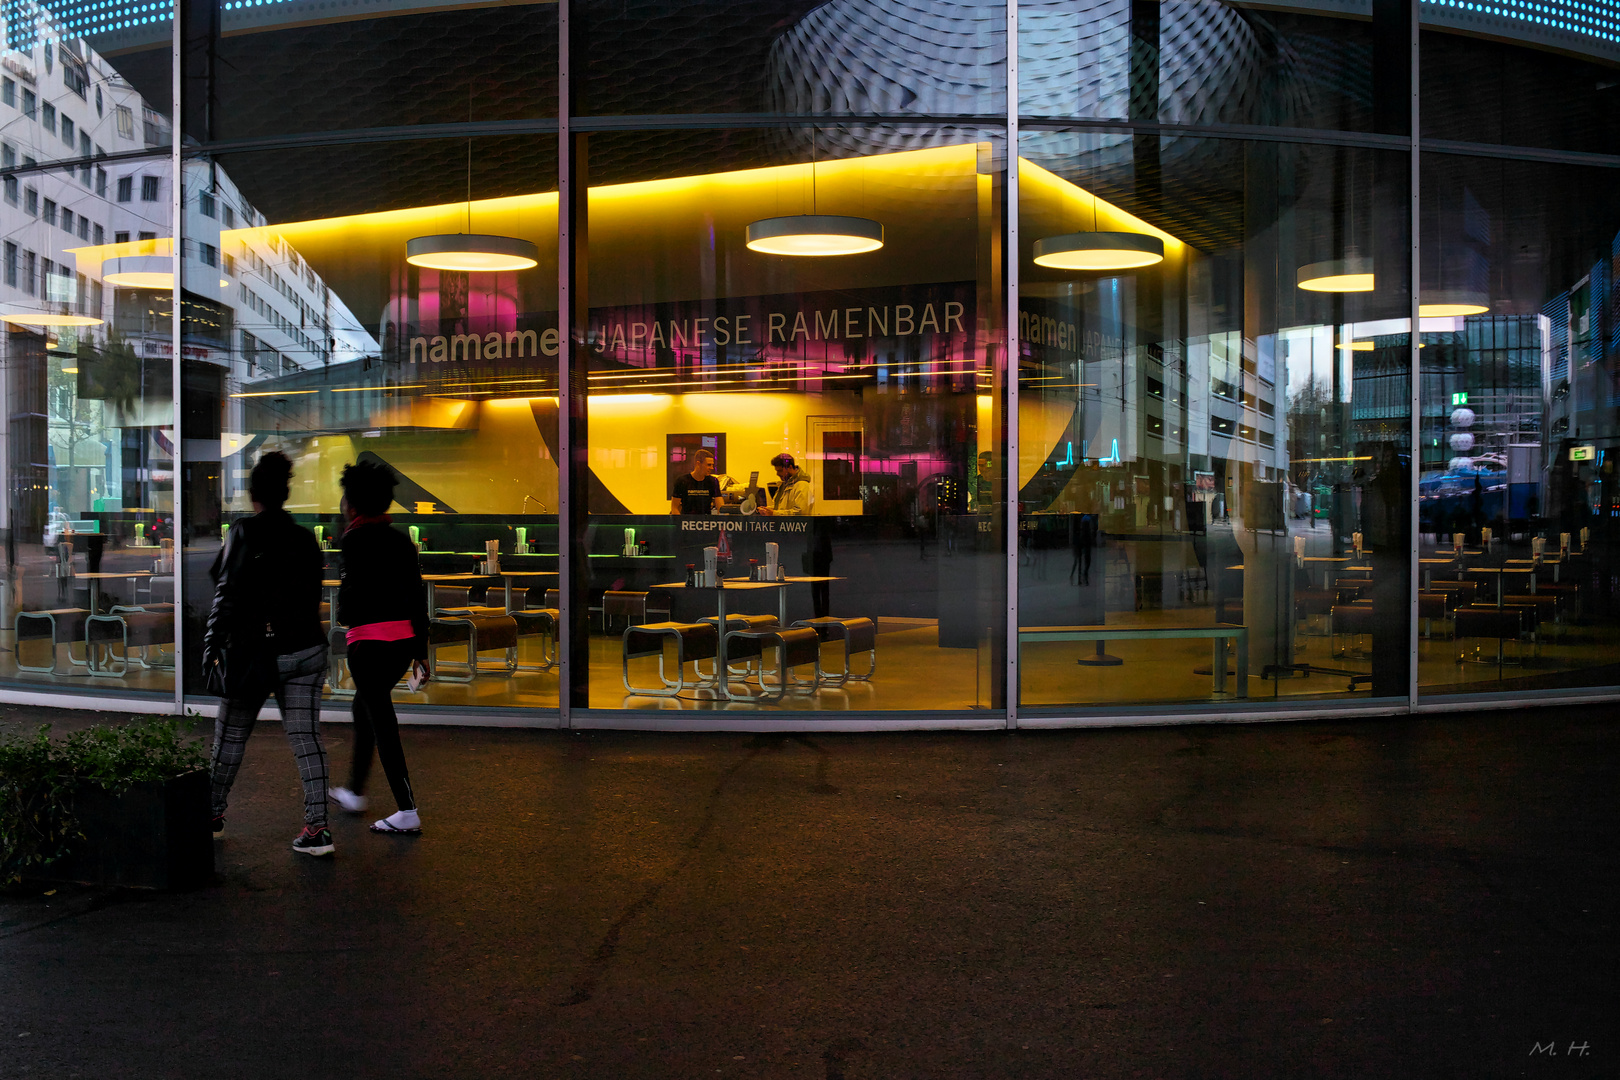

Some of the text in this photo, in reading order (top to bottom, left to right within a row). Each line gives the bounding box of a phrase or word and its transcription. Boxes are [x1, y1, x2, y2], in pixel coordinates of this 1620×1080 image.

[594, 314, 752, 353] JAPANESE
[768, 301, 965, 343] RAMENBAR
[681, 520, 808, 532] RECEPTION TAKE AWAY
